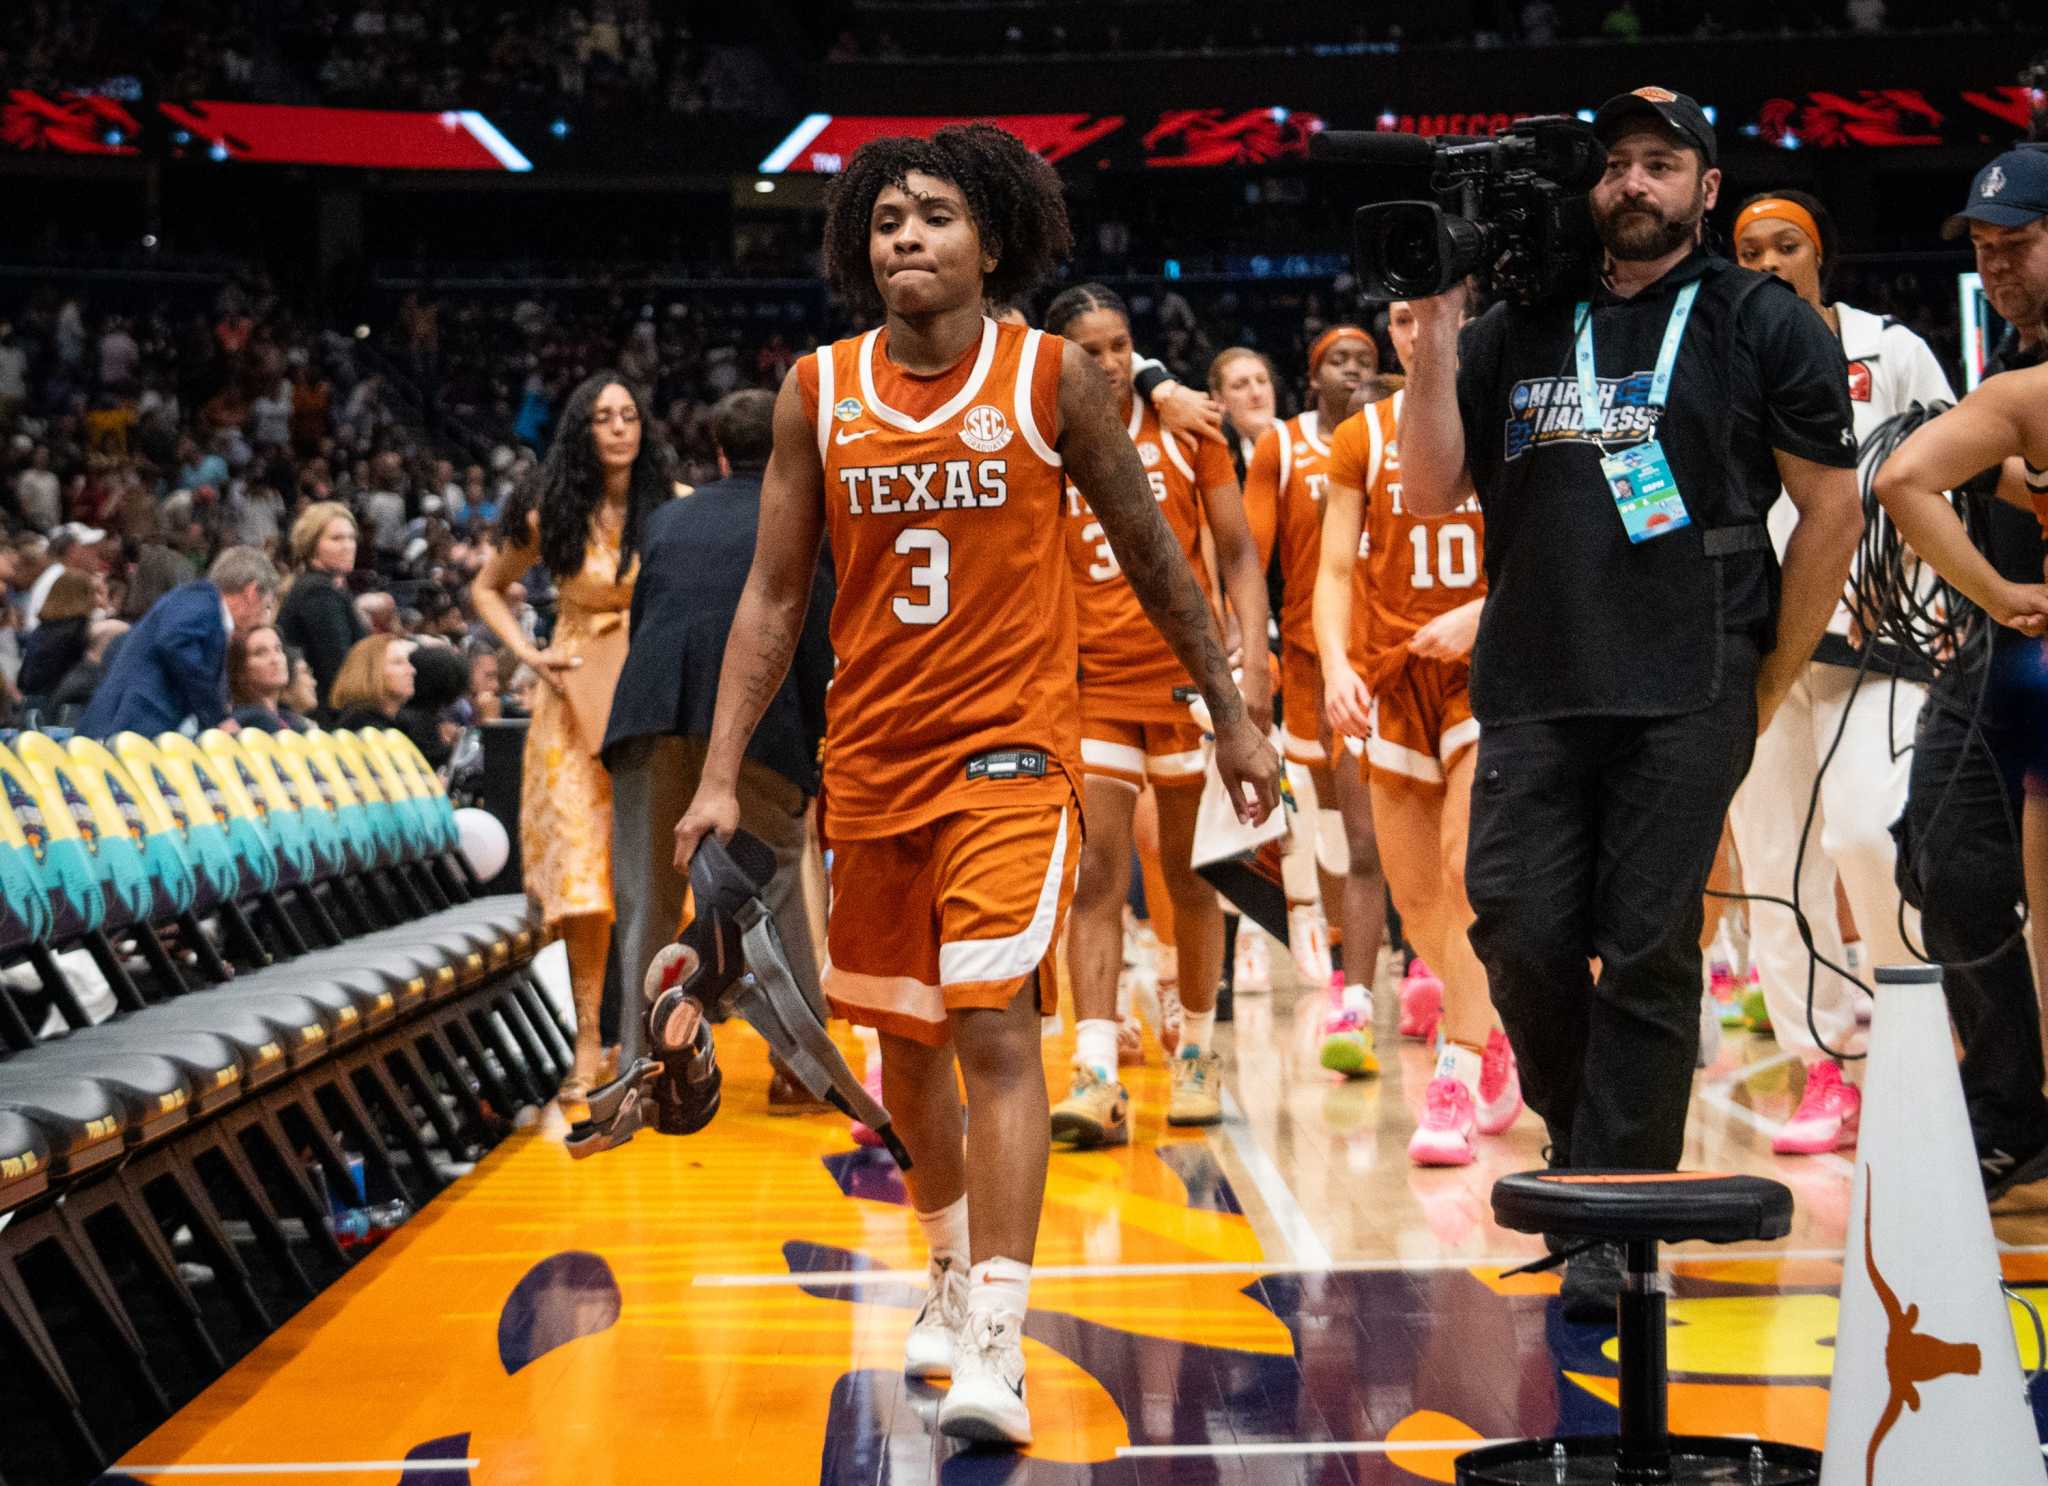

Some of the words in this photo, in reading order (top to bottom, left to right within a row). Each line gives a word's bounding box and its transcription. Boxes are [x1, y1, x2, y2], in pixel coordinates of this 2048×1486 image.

[1528, 381, 1617, 409] MARH
[967, 408, 1003, 440] SEC
[839, 460, 1008, 515] TEXAS
[892, 528, 951, 625] 3
[1409, 523, 1478, 588] 10
[1021, 757, 1036, 768] 42
